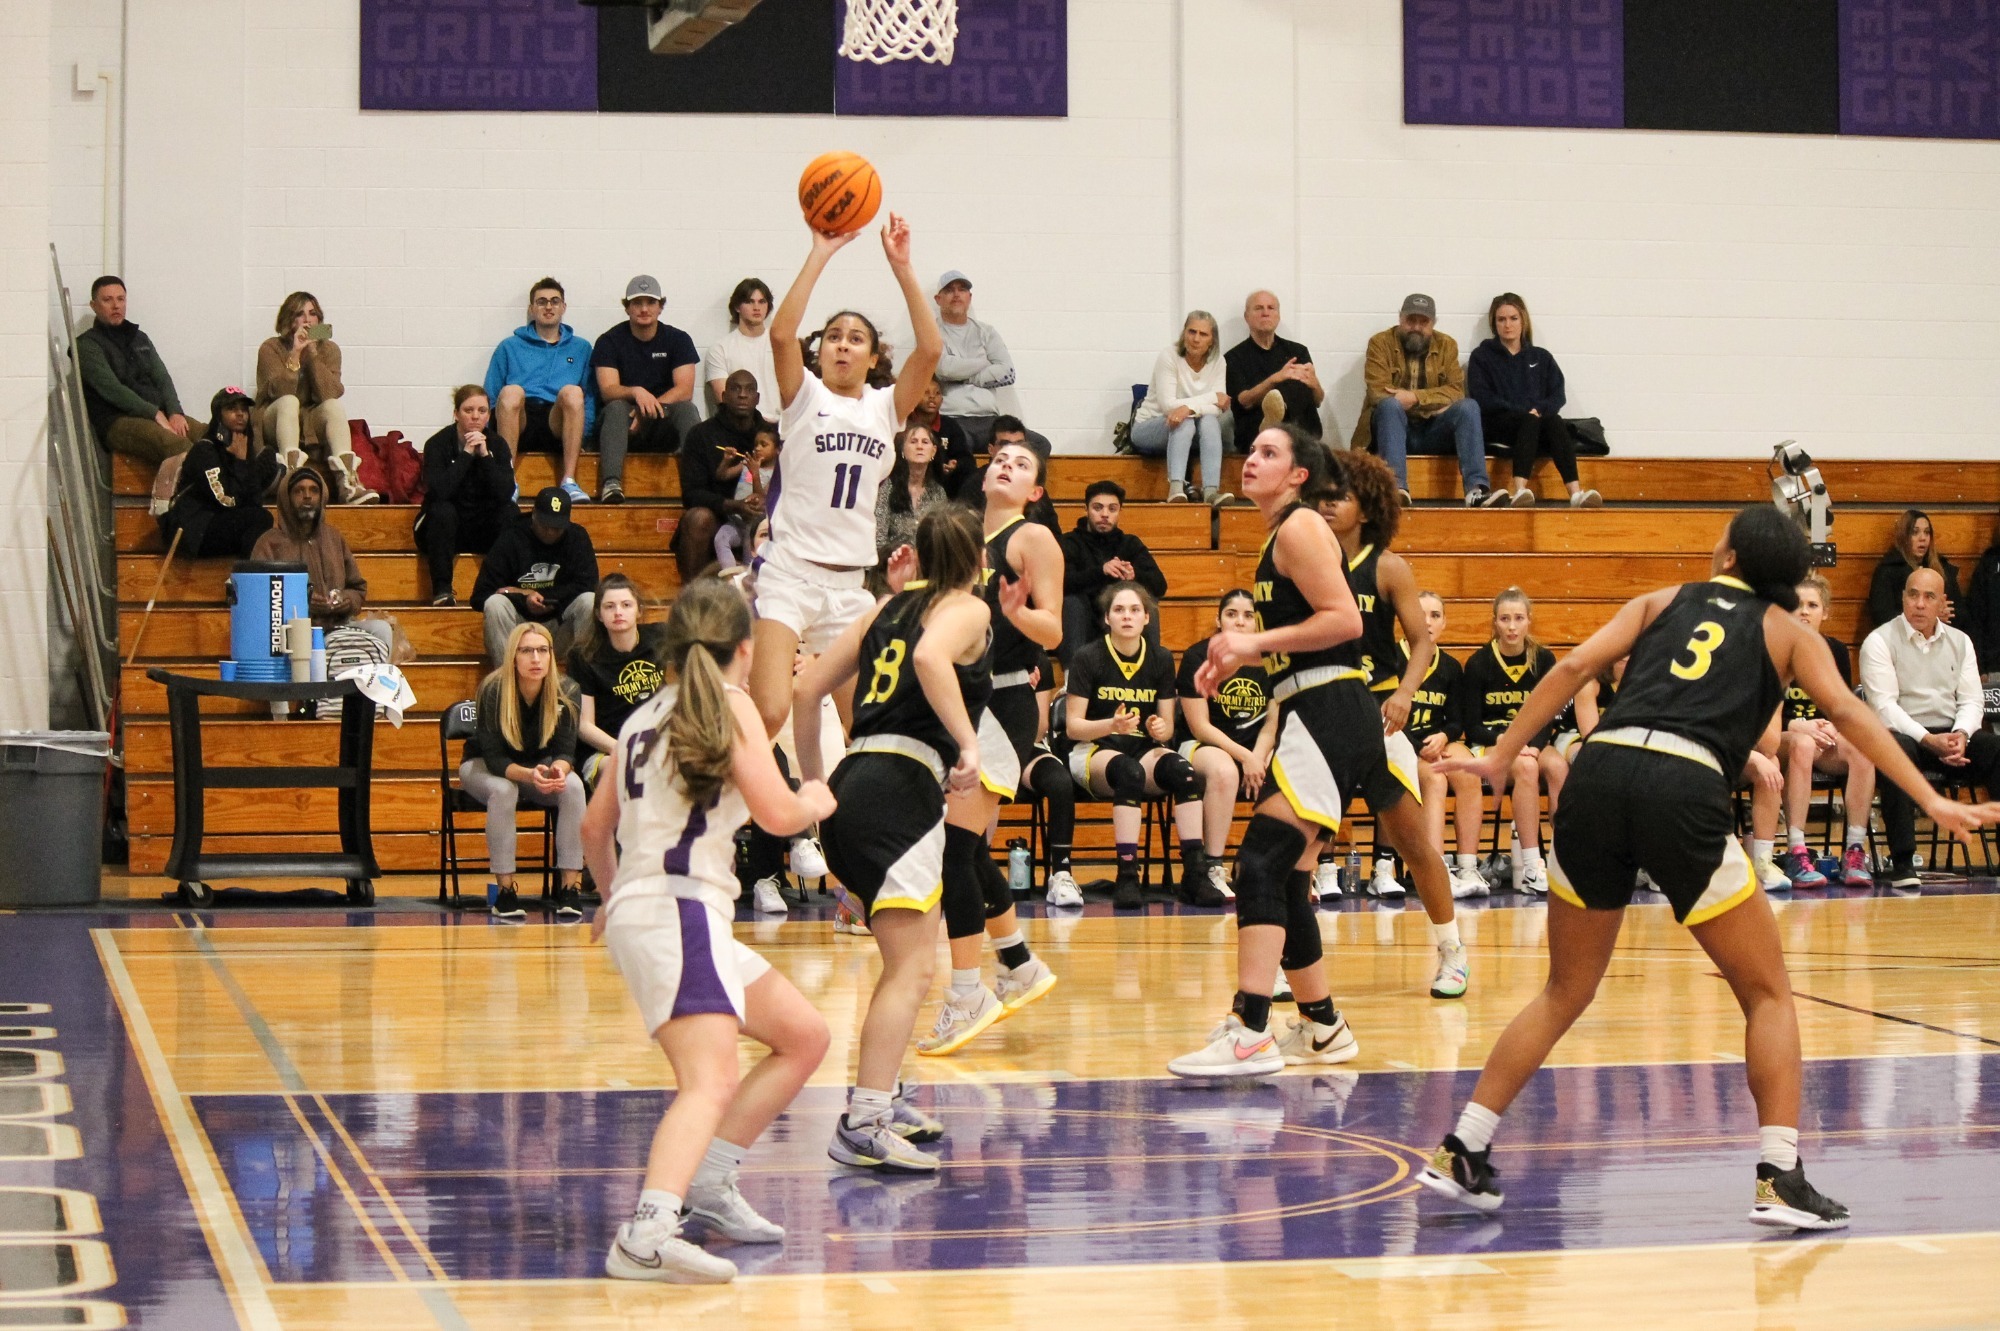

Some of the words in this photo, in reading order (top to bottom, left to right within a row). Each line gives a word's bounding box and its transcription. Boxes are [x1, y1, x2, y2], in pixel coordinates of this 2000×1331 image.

[374, 67, 584, 98] INTEGRITY
[850, 64, 1055, 104] LEGACY
[1417, 63, 1612, 118] PRIDE
[1852, 78, 1991, 126] GRIT
[803, 170, 843, 210] Wilson
[815, 432, 886, 460] SCOTTIES
[830, 463, 862, 510] 11
[271, 580, 282, 653] POWERADE
[1670, 621, 1726, 680] 3
[1098, 687, 1158, 703] STORMY
[1485, 690, 1532, 705] STOR
